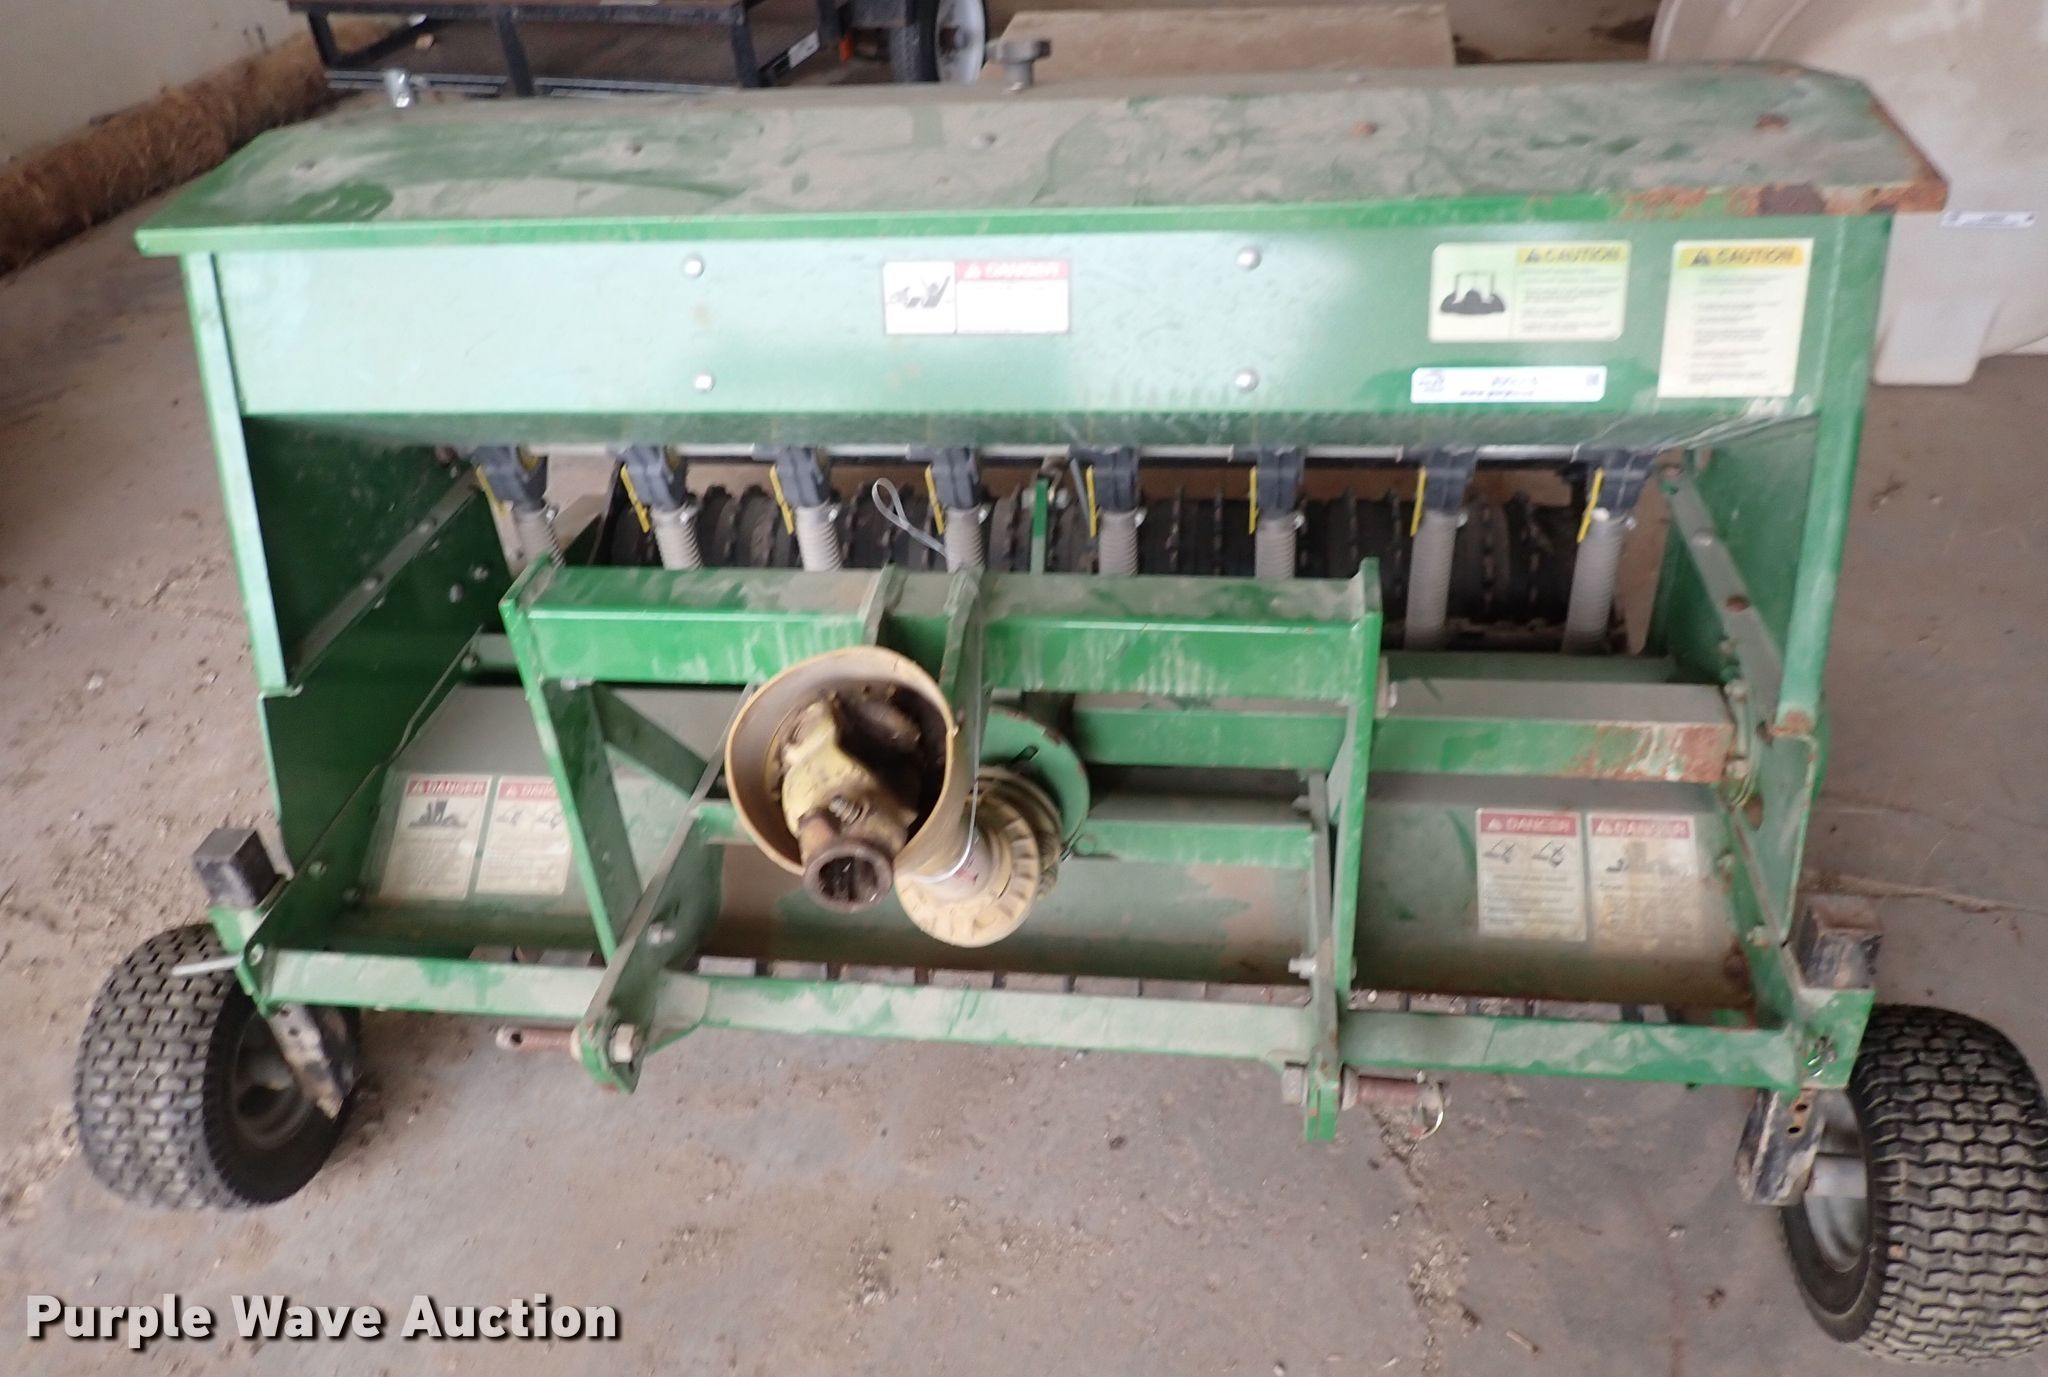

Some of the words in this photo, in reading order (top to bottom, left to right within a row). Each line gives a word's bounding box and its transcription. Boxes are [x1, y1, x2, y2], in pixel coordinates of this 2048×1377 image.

[1546, 246, 1620, 263] CAUTION
[1715, 247, 1795, 265] CAUTION
[426, 780, 486, 796] DANGER
[1506, 817, 1571, 832] DANGER
